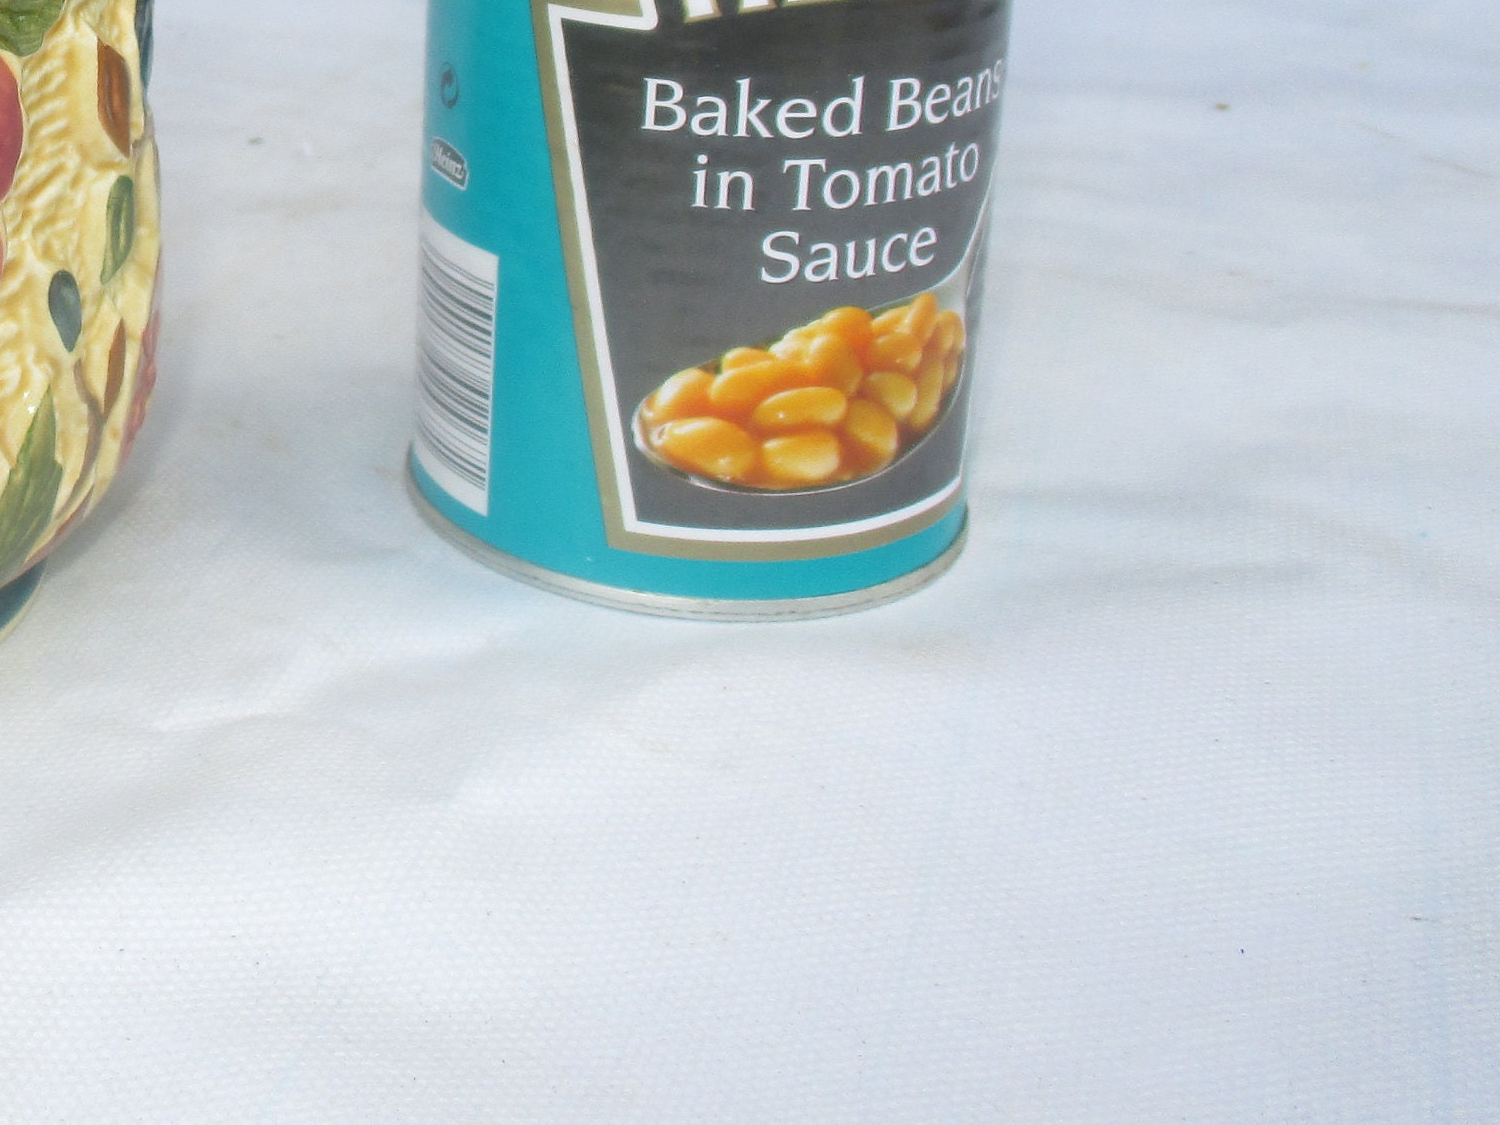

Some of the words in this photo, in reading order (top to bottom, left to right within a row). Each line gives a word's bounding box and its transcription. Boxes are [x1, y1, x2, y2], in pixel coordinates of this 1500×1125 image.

[642, 76, 865, 139] Baked
[886, 59, 1002, 131] Beans
[690, 154, 755, 211] in
[783, 141, 980, 212] Tomato
[761, 225, 937, 284] Sauce
